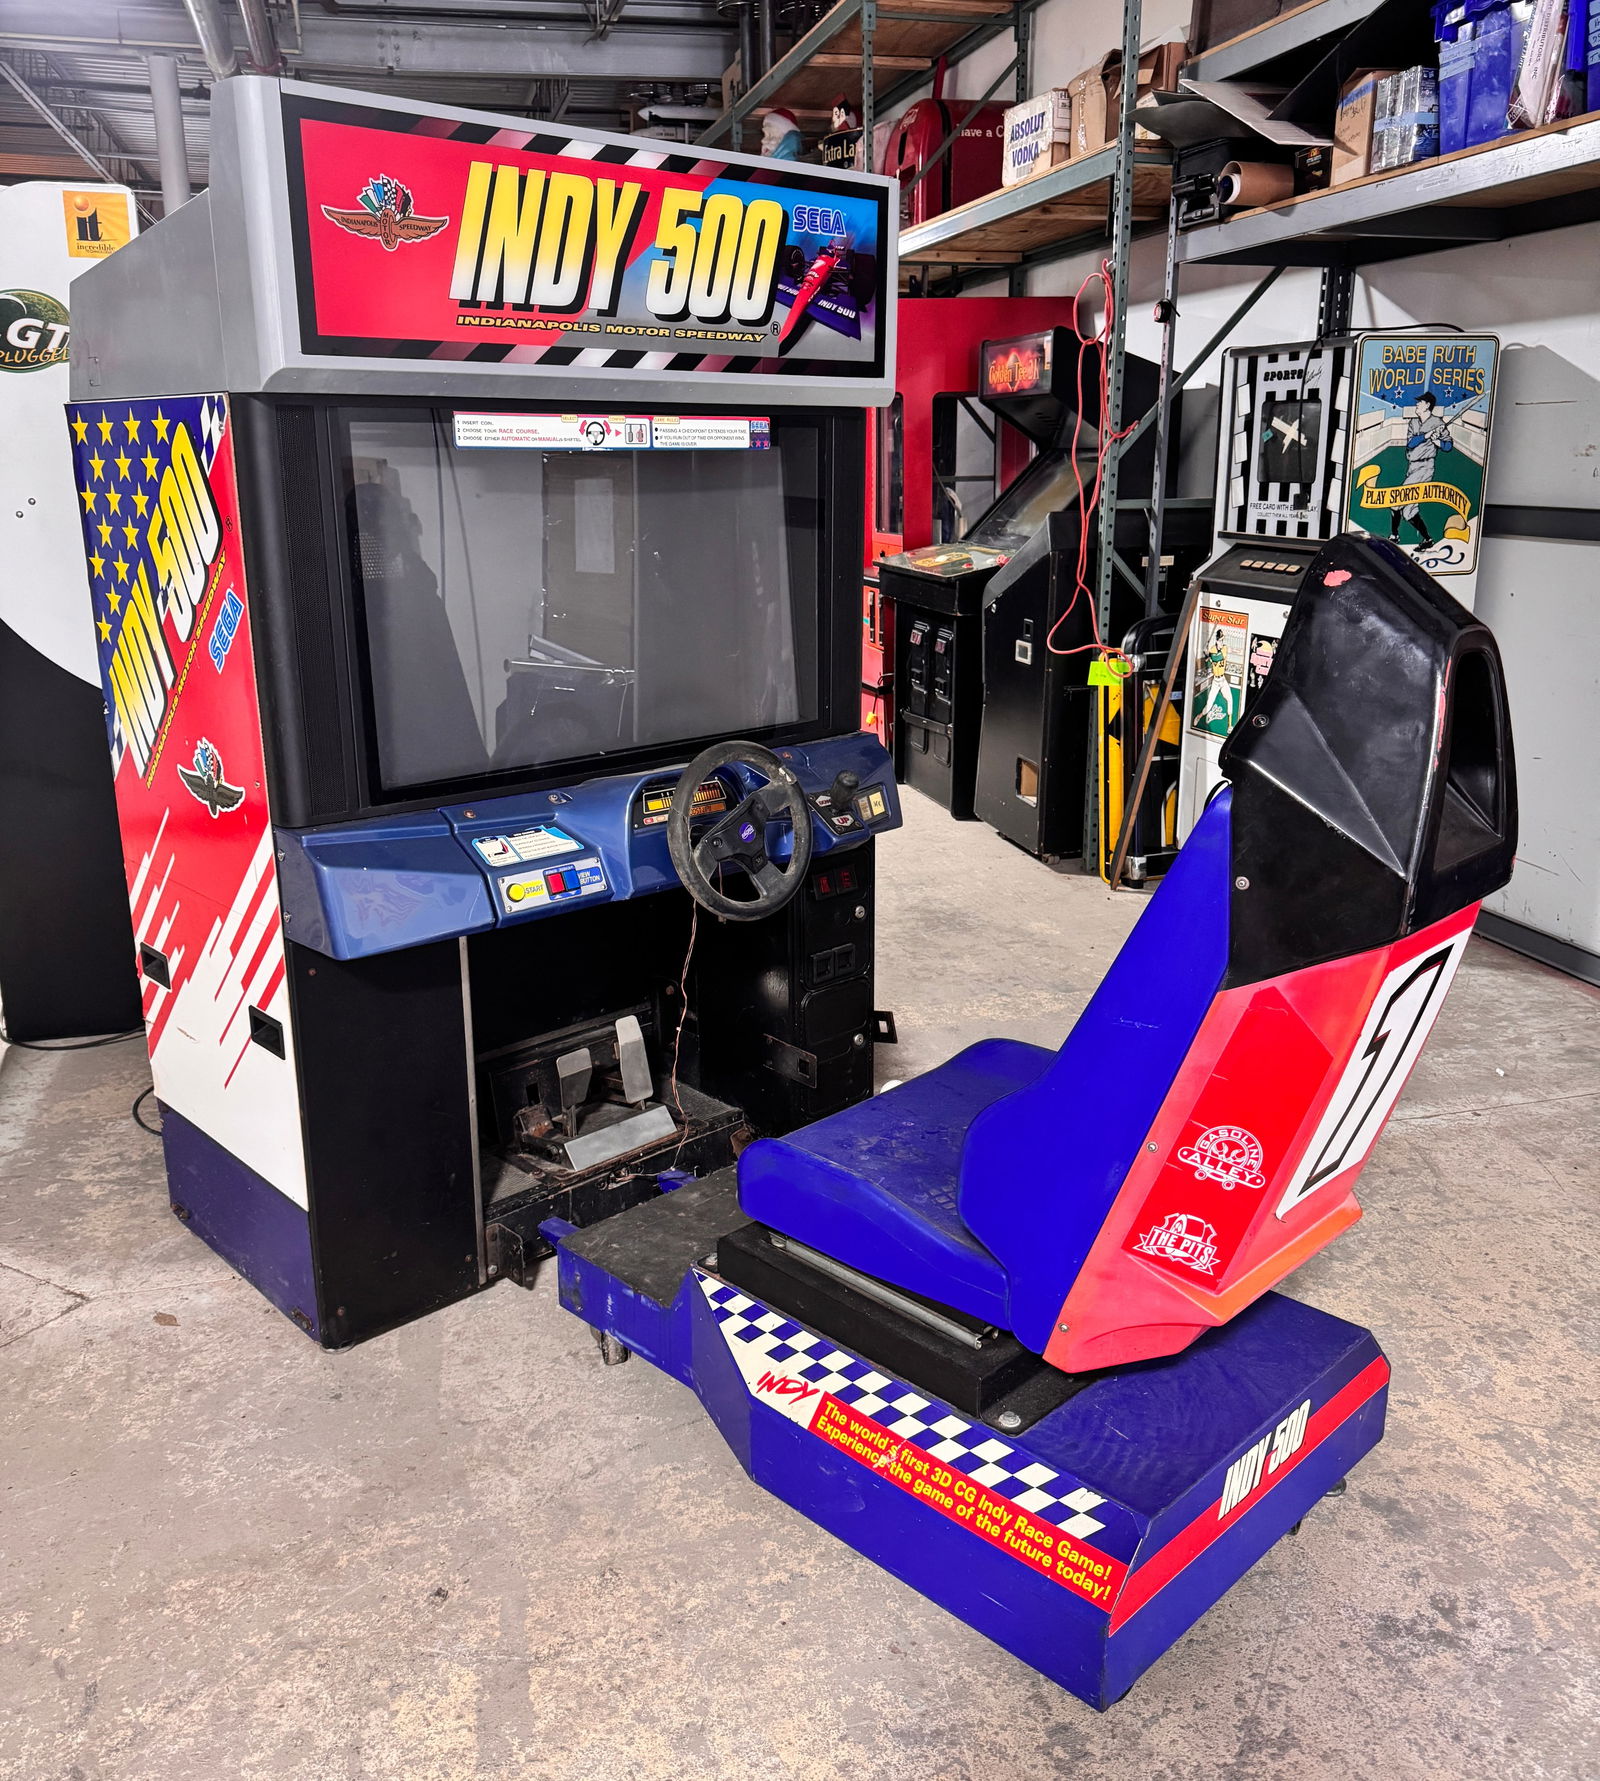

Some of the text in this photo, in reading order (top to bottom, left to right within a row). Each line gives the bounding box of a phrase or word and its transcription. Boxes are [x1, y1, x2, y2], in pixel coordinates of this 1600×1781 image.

[995, 125, 1004, 138] C
[1010, 112, 1046, 143] ABSOLUT
[825, 139, 855, 164] Extra La
[1012, 141, 1040, 167] VODKA
[340, 216, 379, 228] INDIANAPOLIS
[399, 223, 432, 232] SPEEDWAY
[793, 204, 847, 237] SEGA
[449, 161, 787, 322] INDY 500
[457, 315, 768, 343] INDIANAPOLIS MOTOR SPEEDWAY
[1382, 345, 1477, 364] BABE RUTH
[1263, 368, 1304, 382] SPORTS
[1369, 368, 1486, 396] WORLD SERIES
[1249, 502, 1262, 510] FREE
[1262, 503, 1276, 511] CARD
[1365, 484, 1468, 516] PLAY SPORTS AUTHORITY
[109, 421, 222, 779] INDY 500
[208, 587, 245, 675] SEGA
[1202, 612, 1245, 626] Super Star
[146, 549, 227, 790] INDIANAPOLIS MOTOR SPEEDWAY
[836, 816, 850, 825] UP
[525, 884, 544, 895] START
[580, 875, 601, 885] BUTTON
[1199, 1128, 1260, 1169] GASOLINE
[1187, 1151, 1257, 1183] ALLEY
[1150, 1228, 1213, 1265] THE PITS
[756, 1370, 820, 1406] INDY
[1217, 1398, 1312, 1521] INDY 500
[824, 1400, 848, 1426] The
[899, 1448, 930, 1476] first
[930, 1467, 953, 1488] 3D
[953, 1480, 978, 1503] CG
[977, 1494, 1013, 1526] Indy
[1013, 1515, 1054, 1548] Race
[1056, 1540, 1113, 1581] Game!
[816, 1415, 1112, 1601] Experience the game of the future today!
